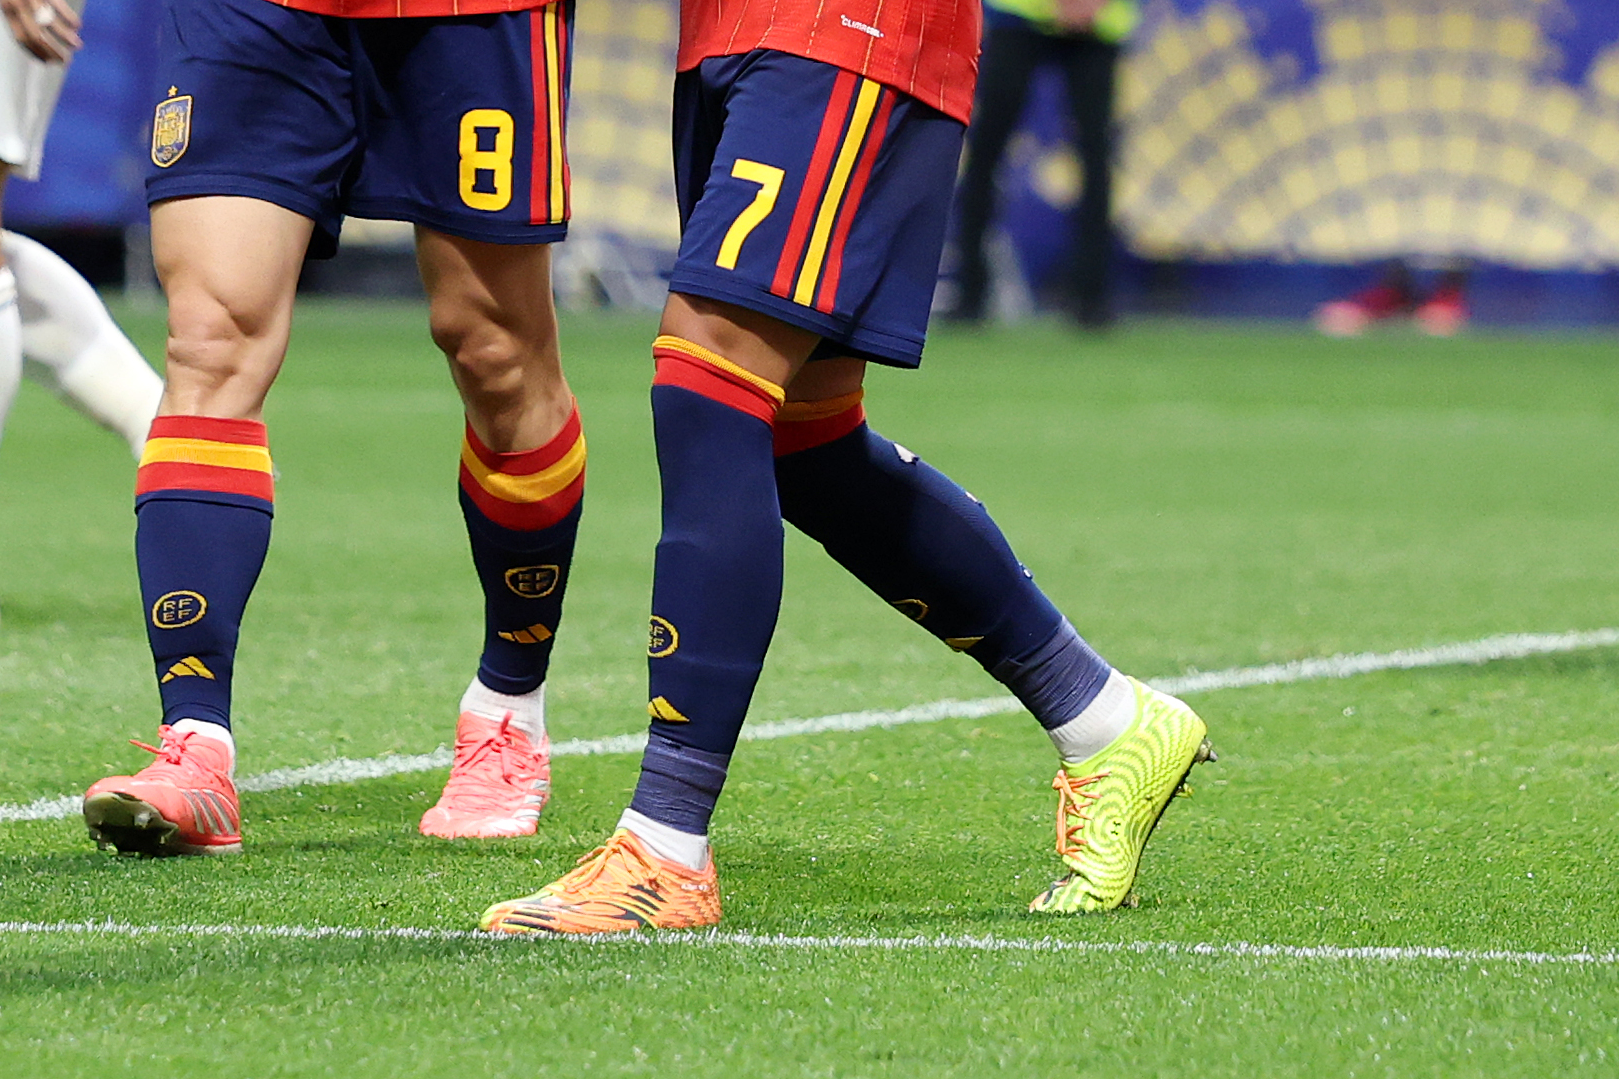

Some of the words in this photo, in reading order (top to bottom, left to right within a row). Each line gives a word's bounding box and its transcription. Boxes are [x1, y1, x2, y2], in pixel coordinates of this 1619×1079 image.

[459, 108, 514, 212] 8
[715, 158, 786, 271] 7
[162, 597, 193, 612] RF
[162, 608, 192, 622] EF
